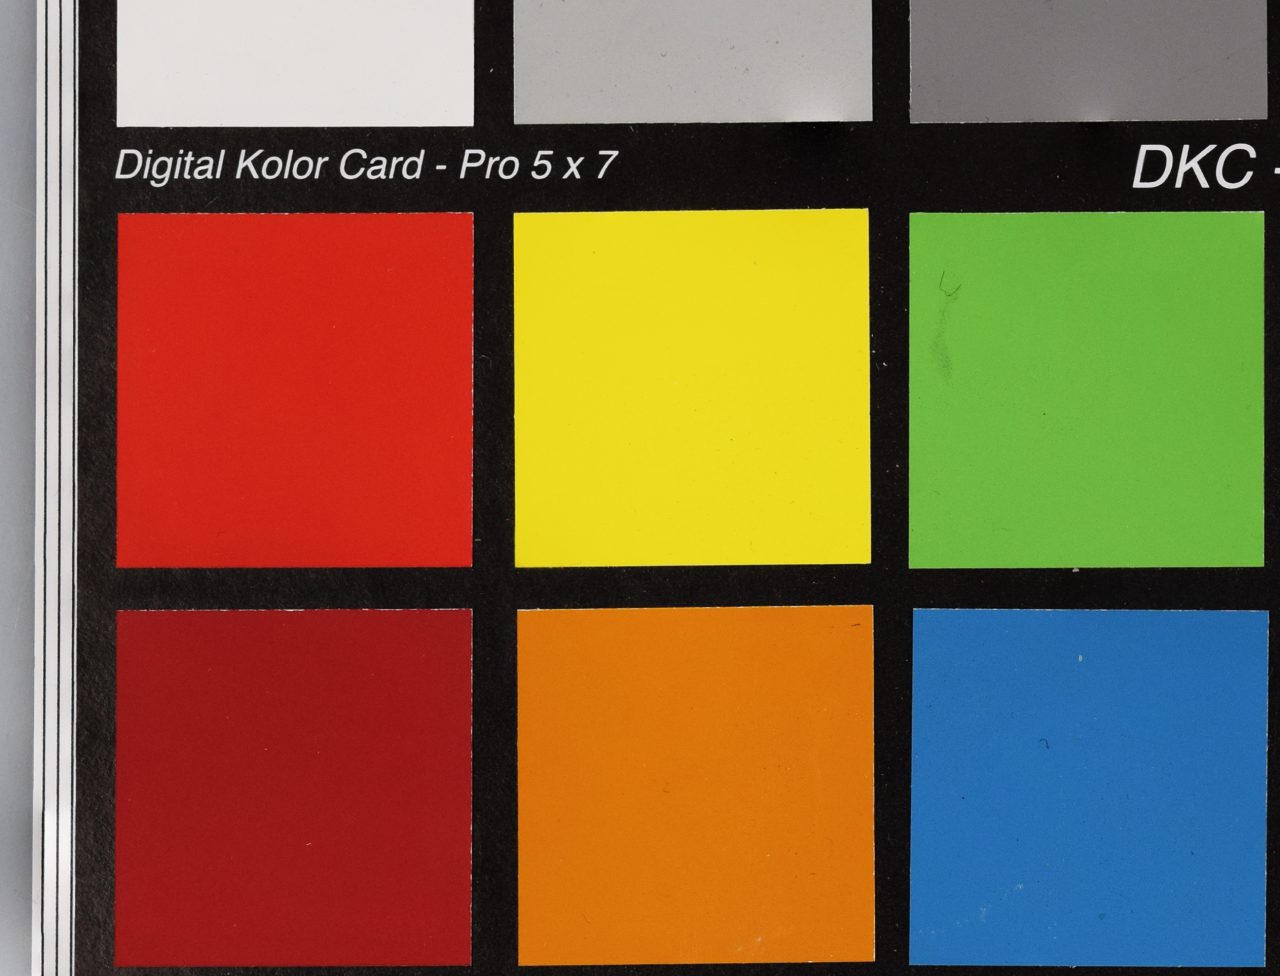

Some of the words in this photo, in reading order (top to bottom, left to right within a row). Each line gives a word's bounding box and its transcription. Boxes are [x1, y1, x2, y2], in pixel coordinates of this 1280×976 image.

[114, 148, 226, 188] Digital
[235, 149, 330, 180] Kolor
[339, 148, 426, 180] Card
[459, 148, 520, 180] Pro
[530, 150, 554, 180] 5
[562, 156, 585, 180] x
[597, 150, 620, 179] 7
[1132, 142, 1257, 190] DKC
